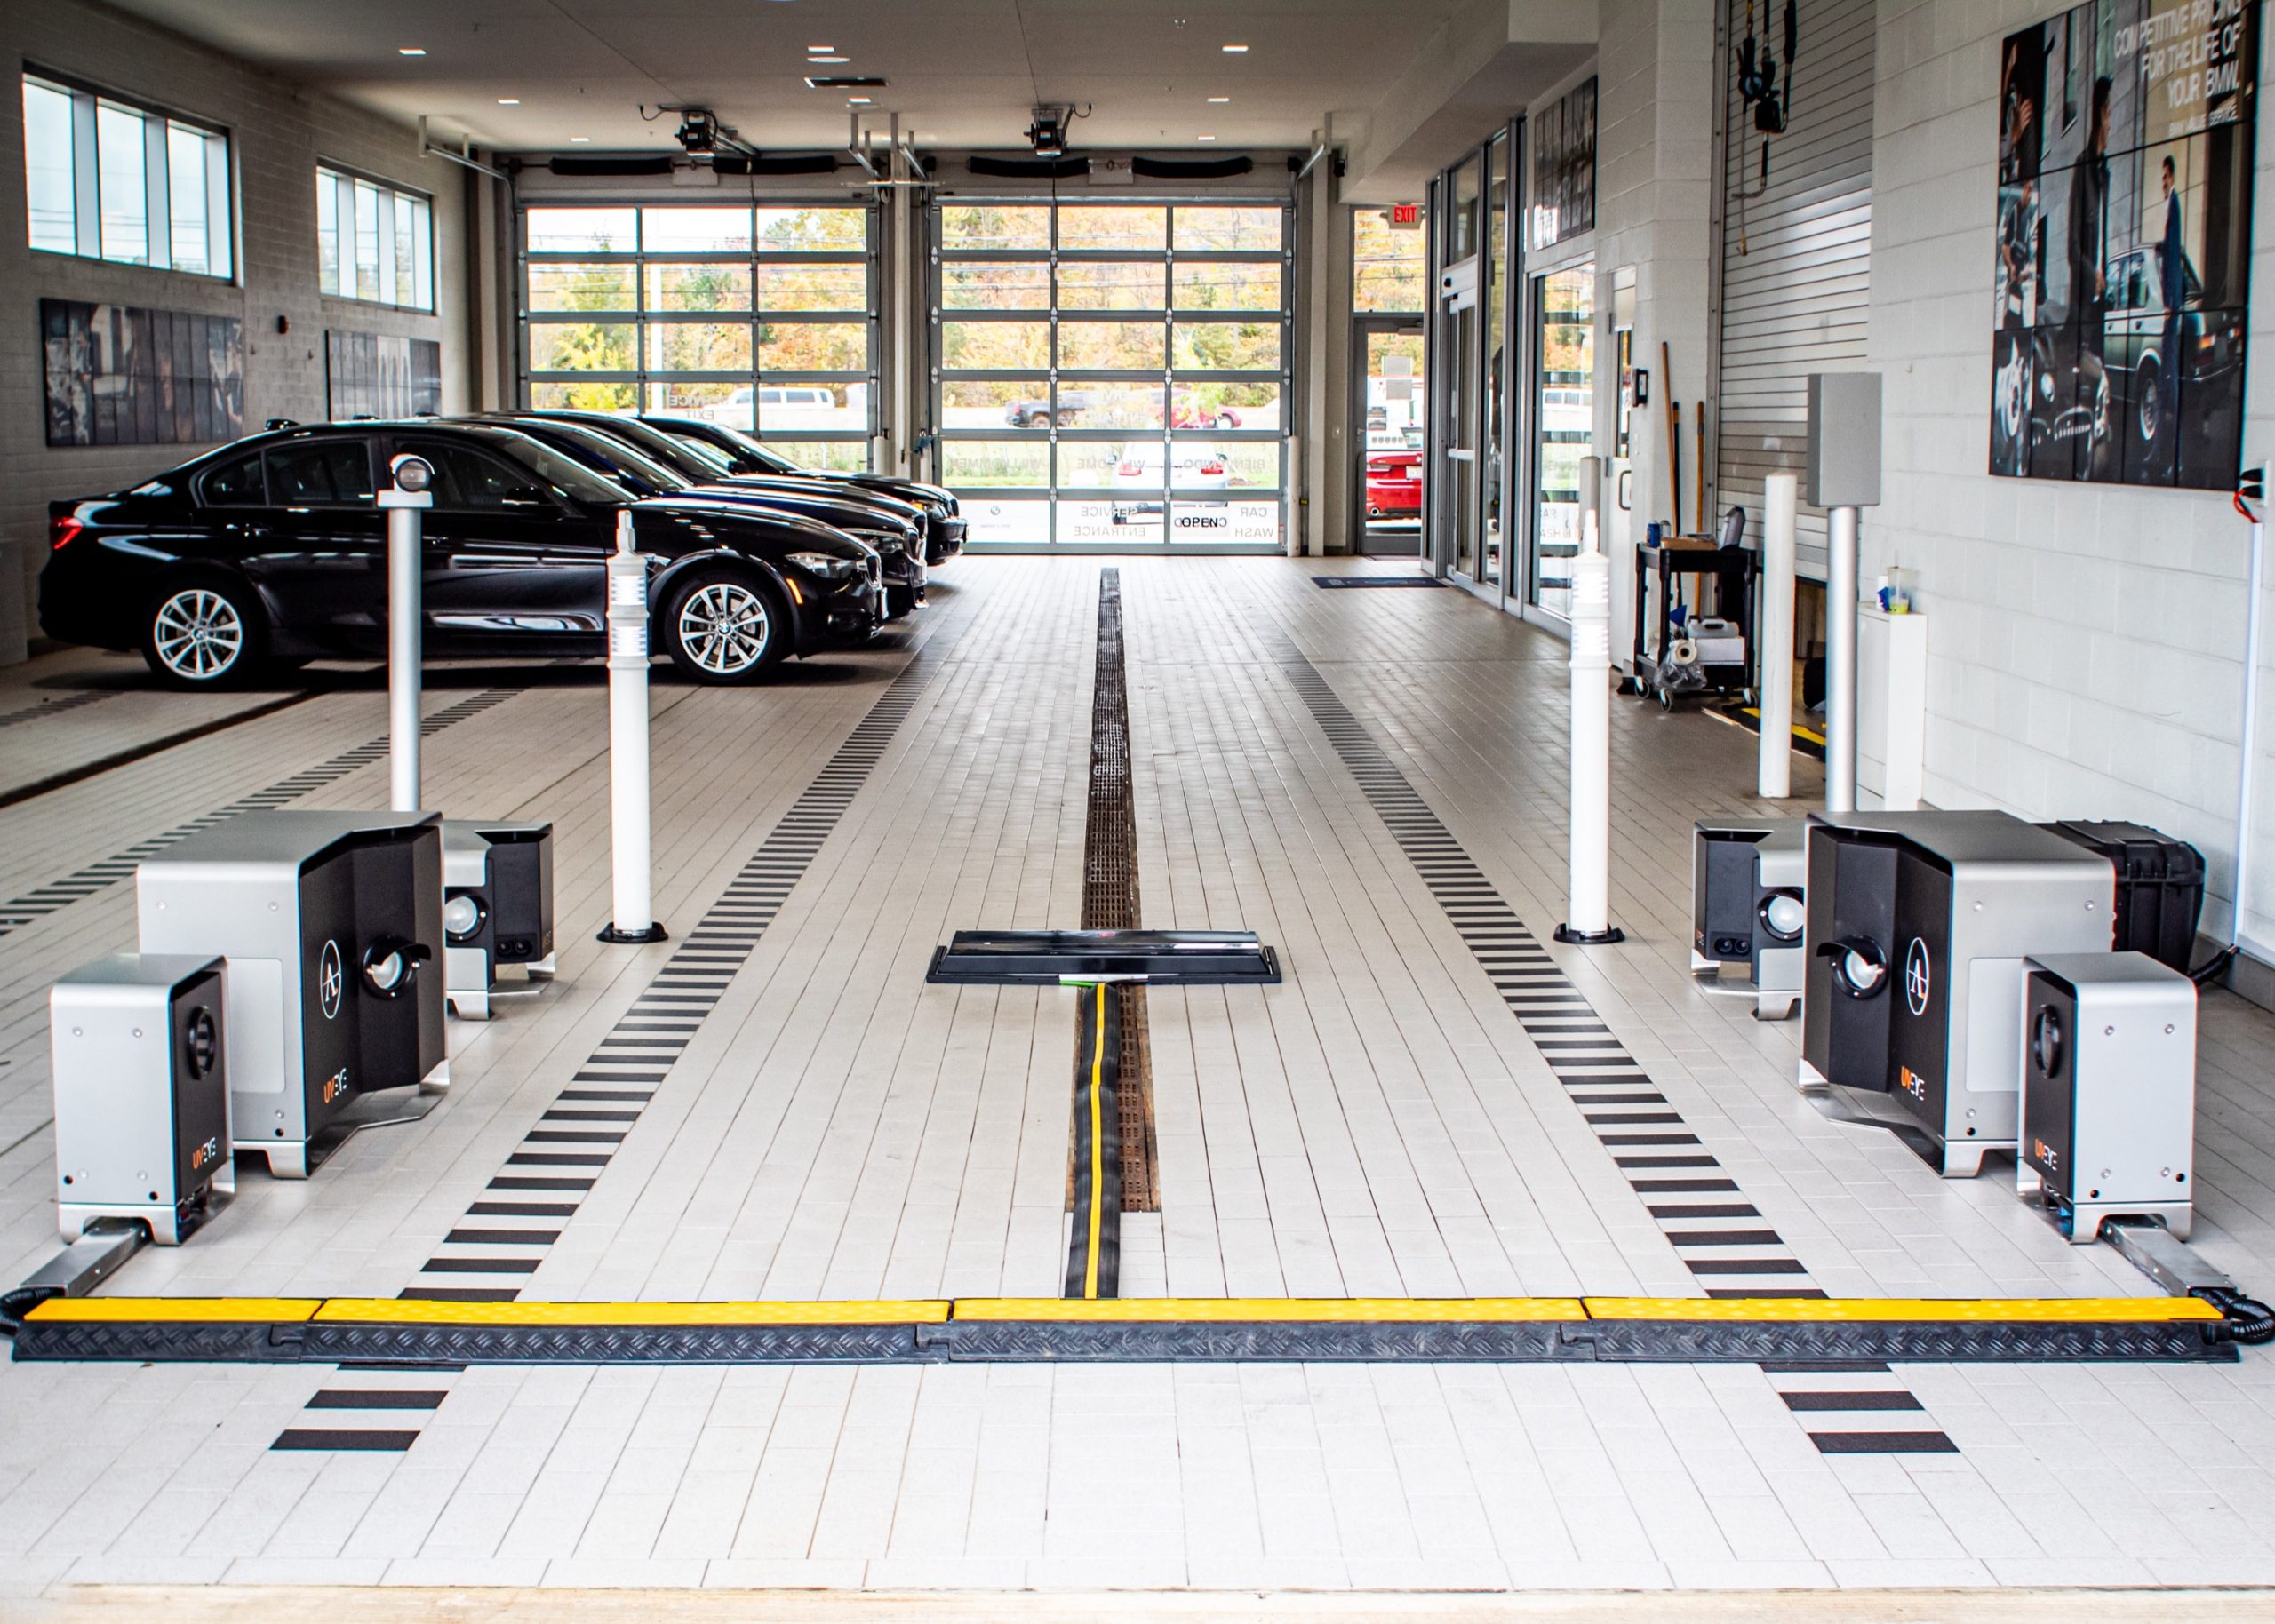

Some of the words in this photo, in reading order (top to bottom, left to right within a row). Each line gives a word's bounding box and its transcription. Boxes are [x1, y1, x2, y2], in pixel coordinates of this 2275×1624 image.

[2113, 4, 2190, 59] COMPETITIVE
[2142, 50, 2165, 81] FOR
[2168, 41, 2190, 71] THE
[2191, 29, 2220, 66] LIFE
[2223, 20, 2241, 56] OF
[2168, 72, 2200, 108] YOUR
[1393, 206, 1417, 223] EXIT
[1181, 517, 1218, 528] OPEN
